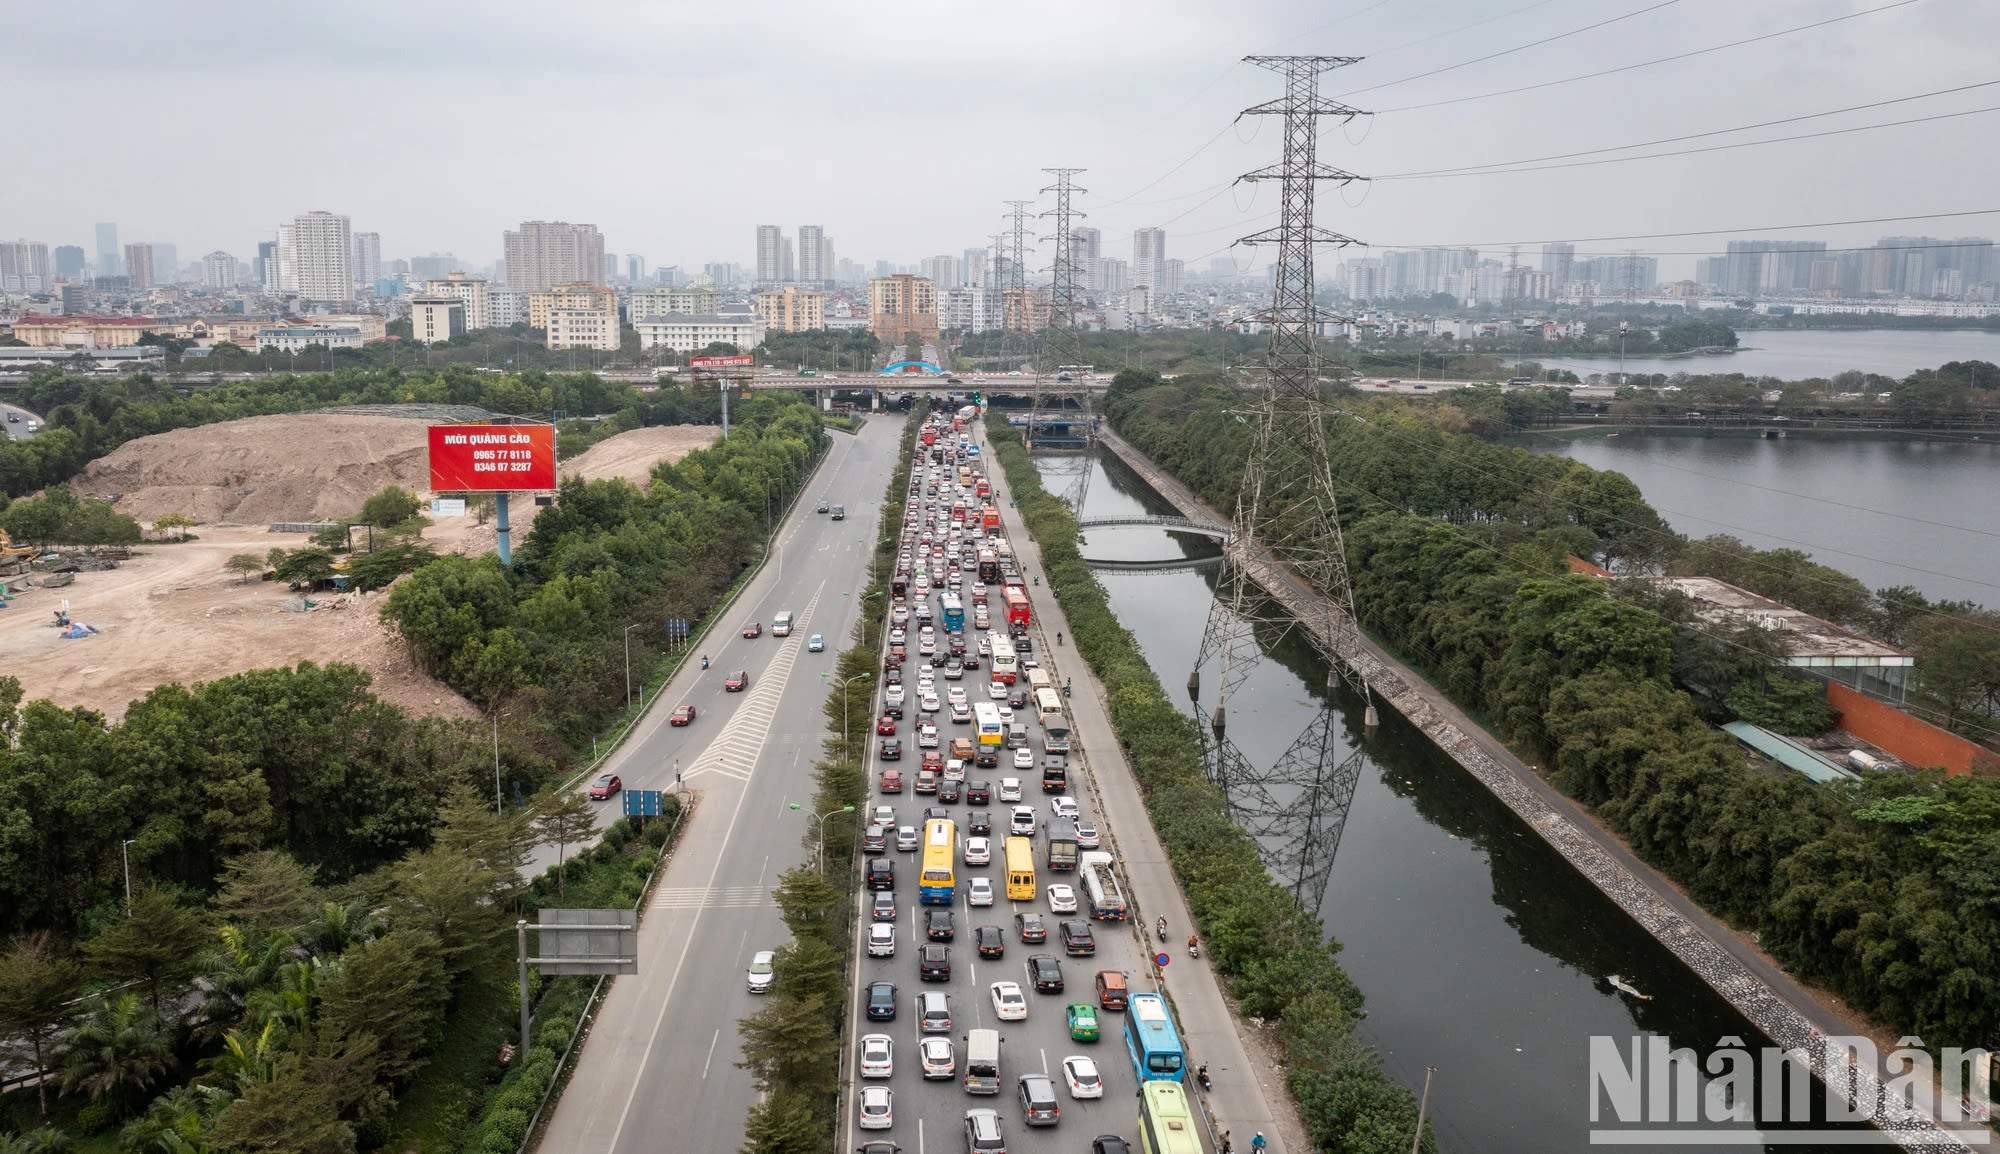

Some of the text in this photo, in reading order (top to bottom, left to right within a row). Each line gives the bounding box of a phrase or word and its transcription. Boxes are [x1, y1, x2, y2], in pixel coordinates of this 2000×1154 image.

[474, 450, 531, 460] 0965 77 8118
[474, 462, 532, 472] 0346 07 3287
